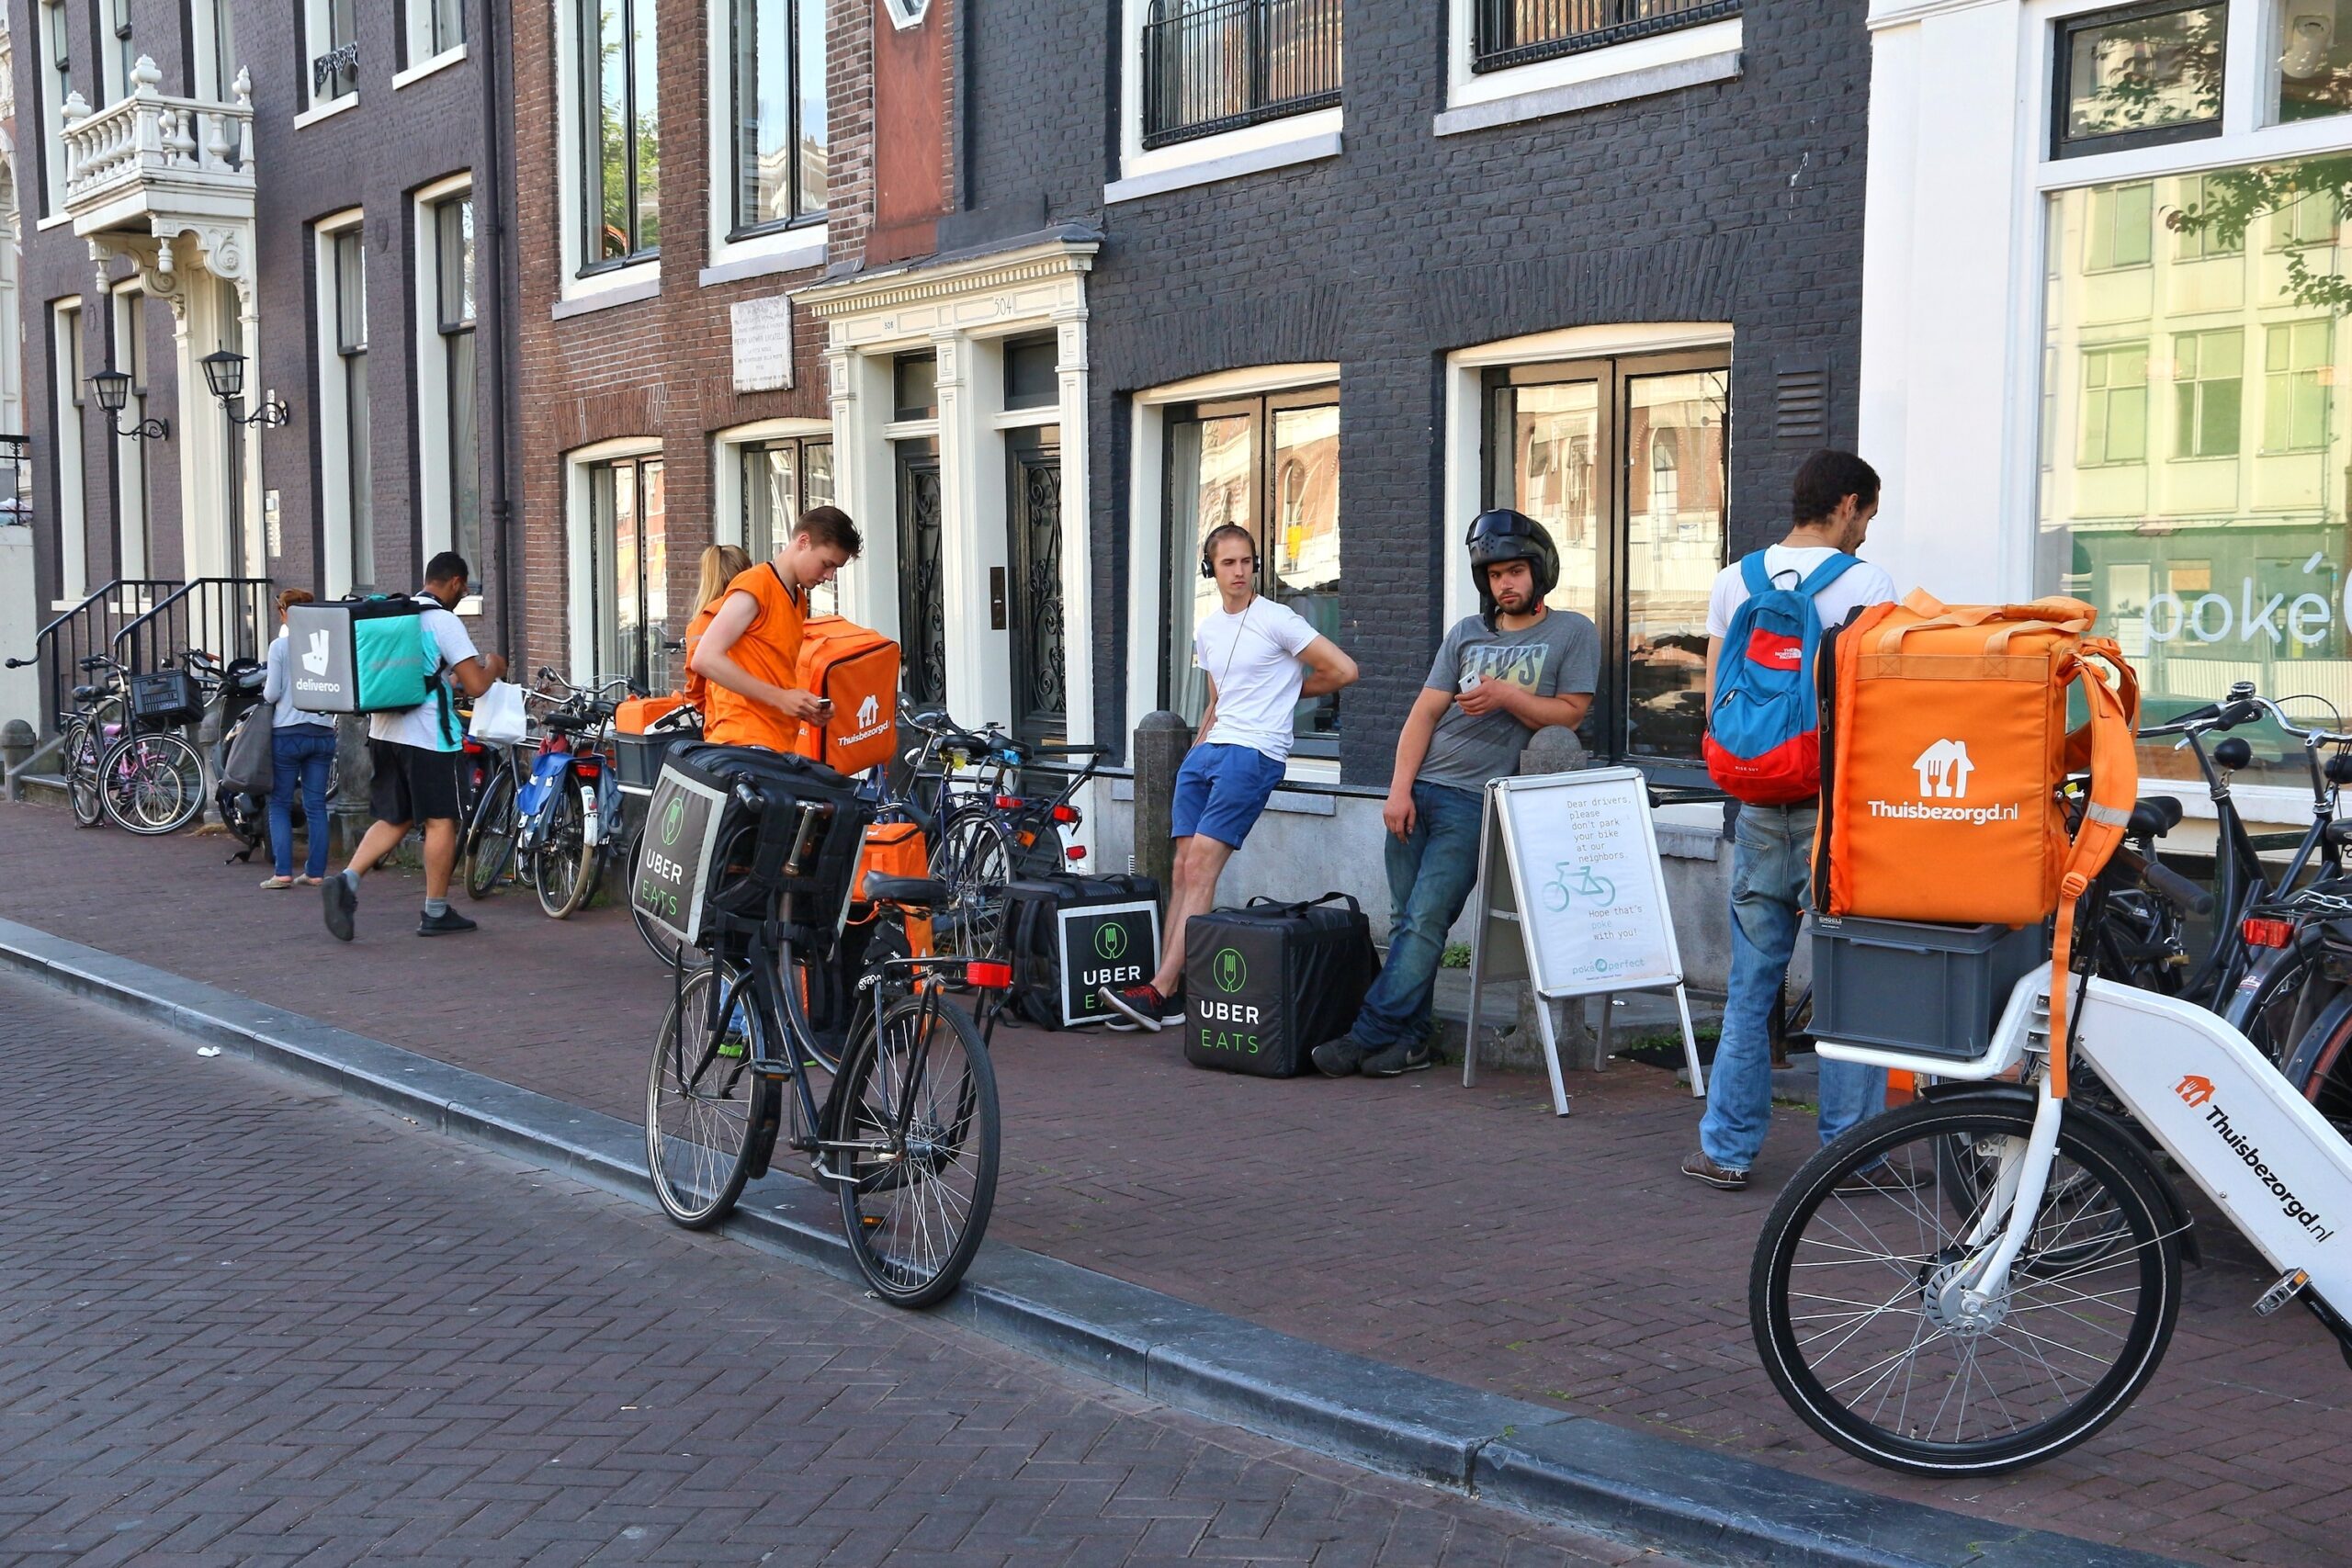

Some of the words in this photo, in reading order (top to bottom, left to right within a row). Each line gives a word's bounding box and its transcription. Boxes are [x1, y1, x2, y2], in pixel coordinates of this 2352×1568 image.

[994, 296, 1012, 316] 504
[2143, 551, 2331, 658] poké
[296, 678, 341, 693] deliveroo
[1566, 800, 1588, 809] Dear
[1591, 795, 1632, 807] drivers,
[1569, 809, 1600, 821] please
[1867, 800, 2018, 826] Thuisbezorgd.nl
[1571, 820, 1596, 830] don't
[1599, 818, 1620, 829] park
[1574, 832, 1594, 843] your
[1598, 829, 1619, 839] bike
[1576, 844, 1588, 852] at
[1590, 842, 1605, 851] our
[646, 848, 683, 886] UBER
[642, 879, 677, 916] EATS
[1589, 908, 1610, 919] Hope
[1614, 904, 1643, 916] that's
[1593, 931, 1614, 941] with
[1617, 928, 1637, 941] you!
[1608, 958, 1645, 972] perfect
[1083, 965, 1141, 986] UBER
[1200, 999, 1260, 1025] UBER
[1202, 1029, 1259, 1054] EATS
[2205, 1104, 2335, 1243] Thuisbezorgd.nl
